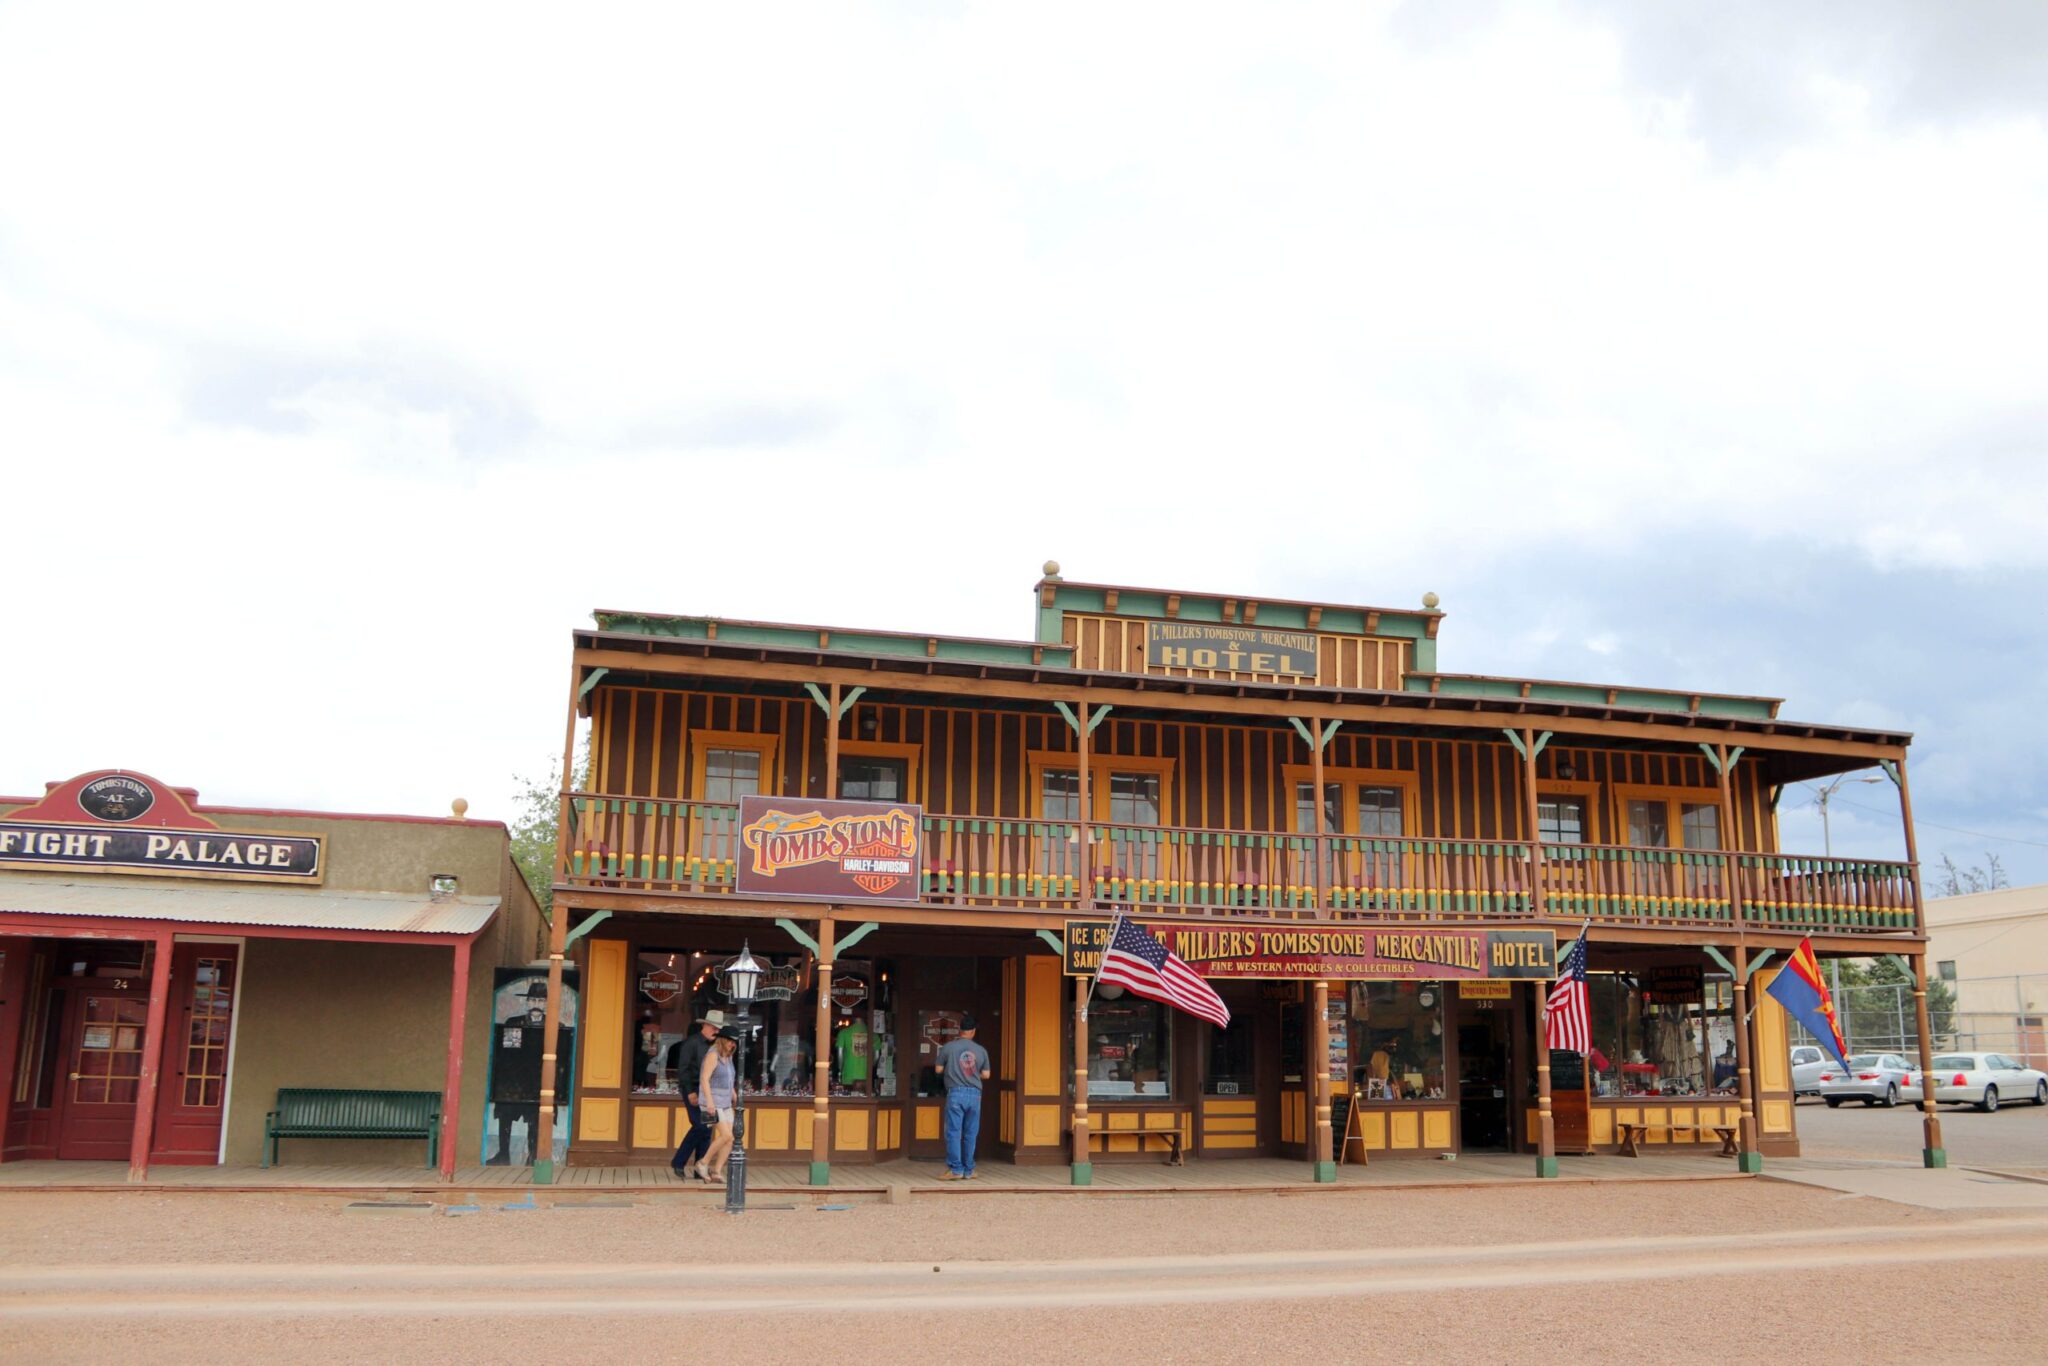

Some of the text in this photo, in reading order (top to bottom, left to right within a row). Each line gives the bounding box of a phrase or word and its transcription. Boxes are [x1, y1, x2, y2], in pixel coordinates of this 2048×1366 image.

[1151, 624, 1315, 653] T. MILLER'S TOMBSTONE MERCANTILE
[1228, 641, 1240, 651] &
[1162, 646, 1305, 675] HOTEL
[88, 778, 148, 798] TOMBSTONE
[0, 831, 293, 867] FIGHT PALACE
[749, 813, 913, 872] TOMBSTONE
[860, 847, 895, 858] MOTOR
[843, 859, 910, 874] HARLEY-DAVIDSON
[859, 876, 895, 891] CYCLES
[1071, 928, 1089, 945] ICE
[1176, 931, 1257, 962] MILLER'S
[1261, 933, 1366, 956] TOMBSTONE
[1376, 935, 1481, 971] MERCANTILE
[1492, 942, 1550, 967] HOTEL
[1211, 962, 1415, 974] FINE WESTERN ANTIQUES & COLLECTIBLES
[113, 979, 129, 989] 24
